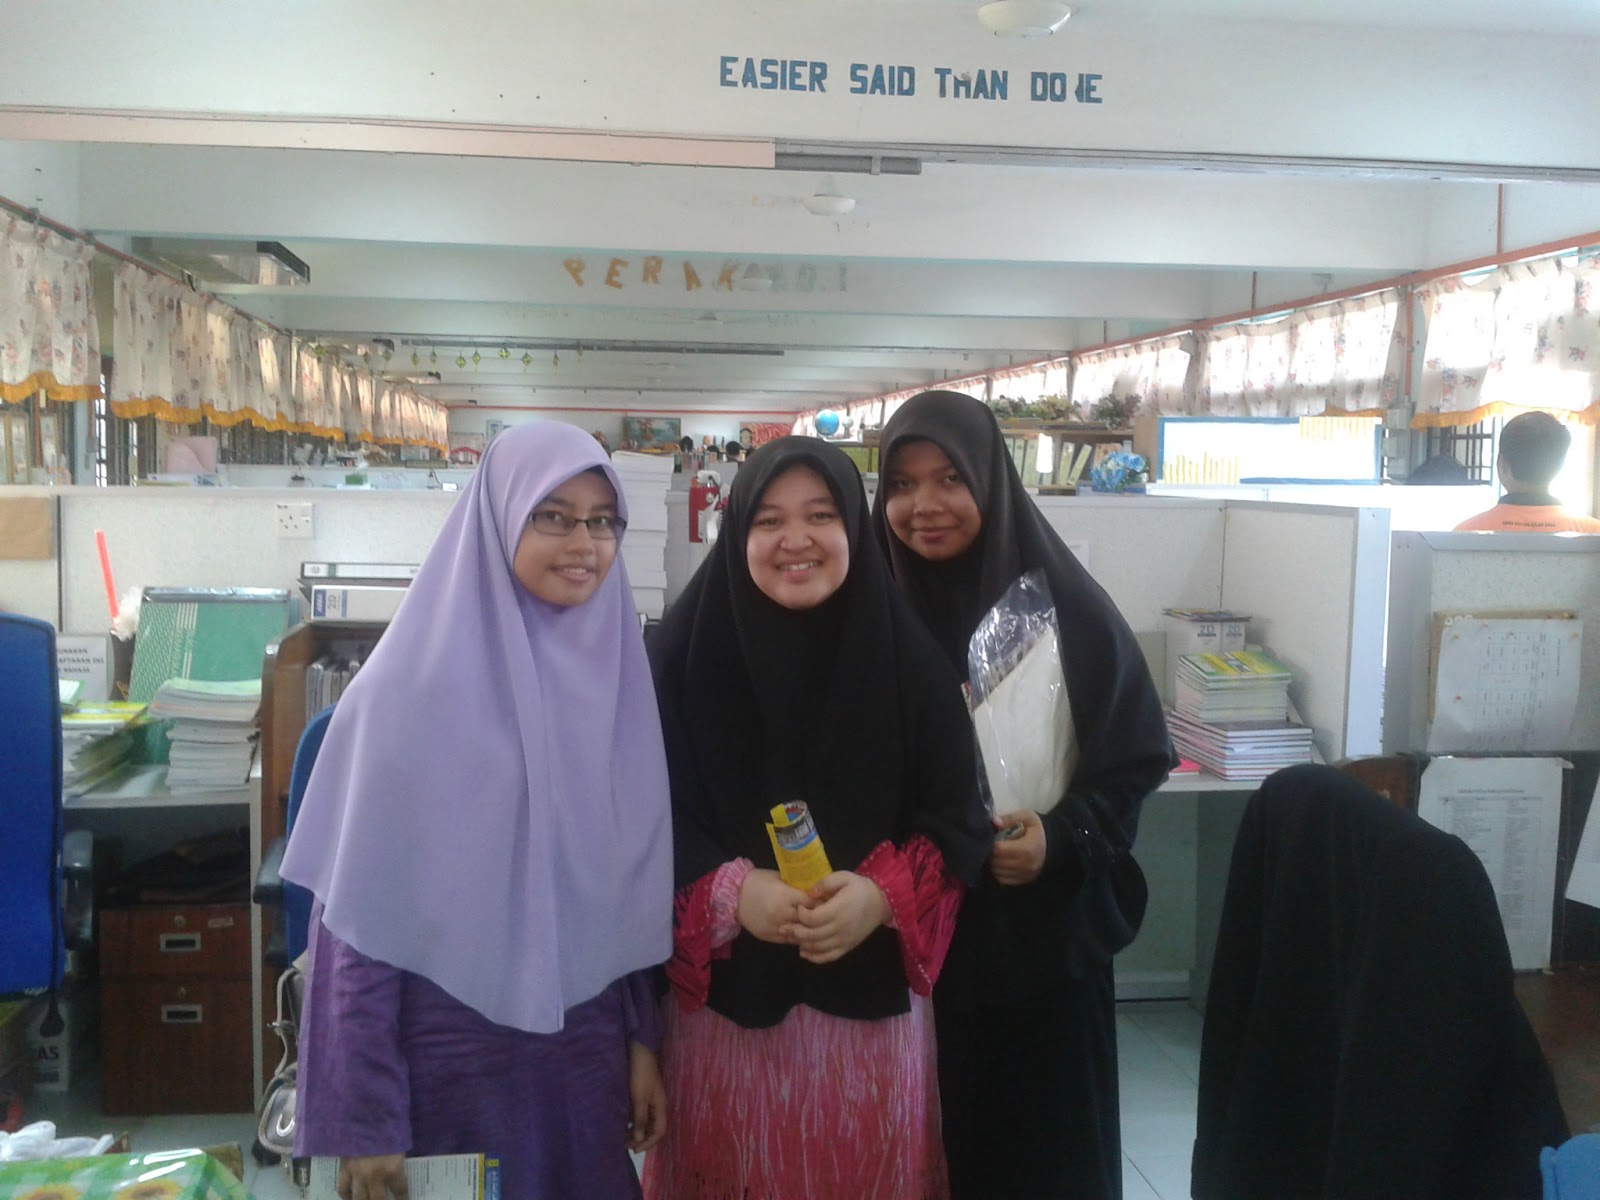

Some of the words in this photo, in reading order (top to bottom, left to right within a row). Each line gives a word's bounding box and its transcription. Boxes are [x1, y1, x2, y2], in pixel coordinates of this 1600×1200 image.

[719, 55, 828, 93] EASIER
[849, 63, 916, 97] SAID
[934, 67, 1008, 101] THAN
